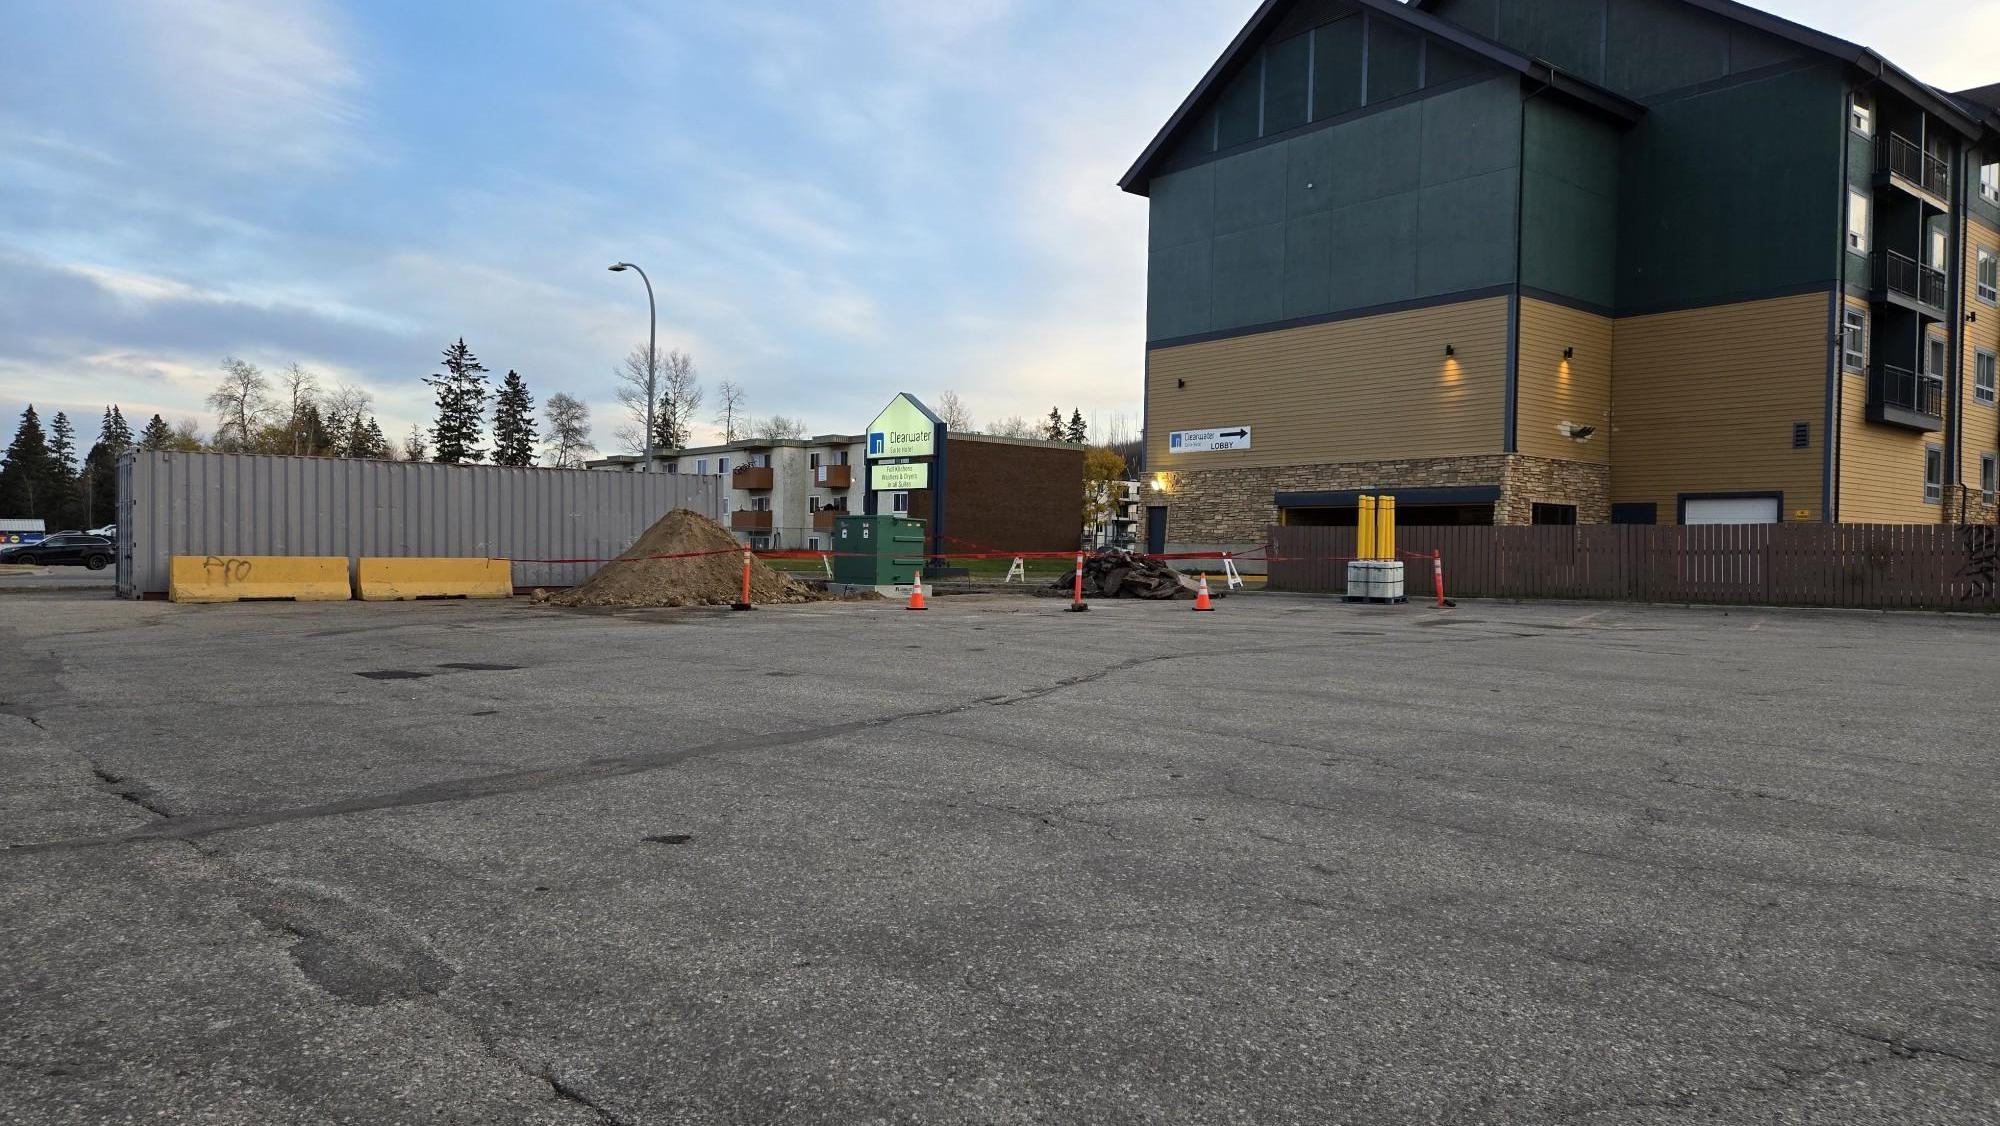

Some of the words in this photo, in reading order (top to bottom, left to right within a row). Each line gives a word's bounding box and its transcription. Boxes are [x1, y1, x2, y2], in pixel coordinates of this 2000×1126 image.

[890, 431, 932, 444] Clearwater
[1184, 432, 1215, 441] Clearwater
[1210, 441, 1234, 449] LOBBY
